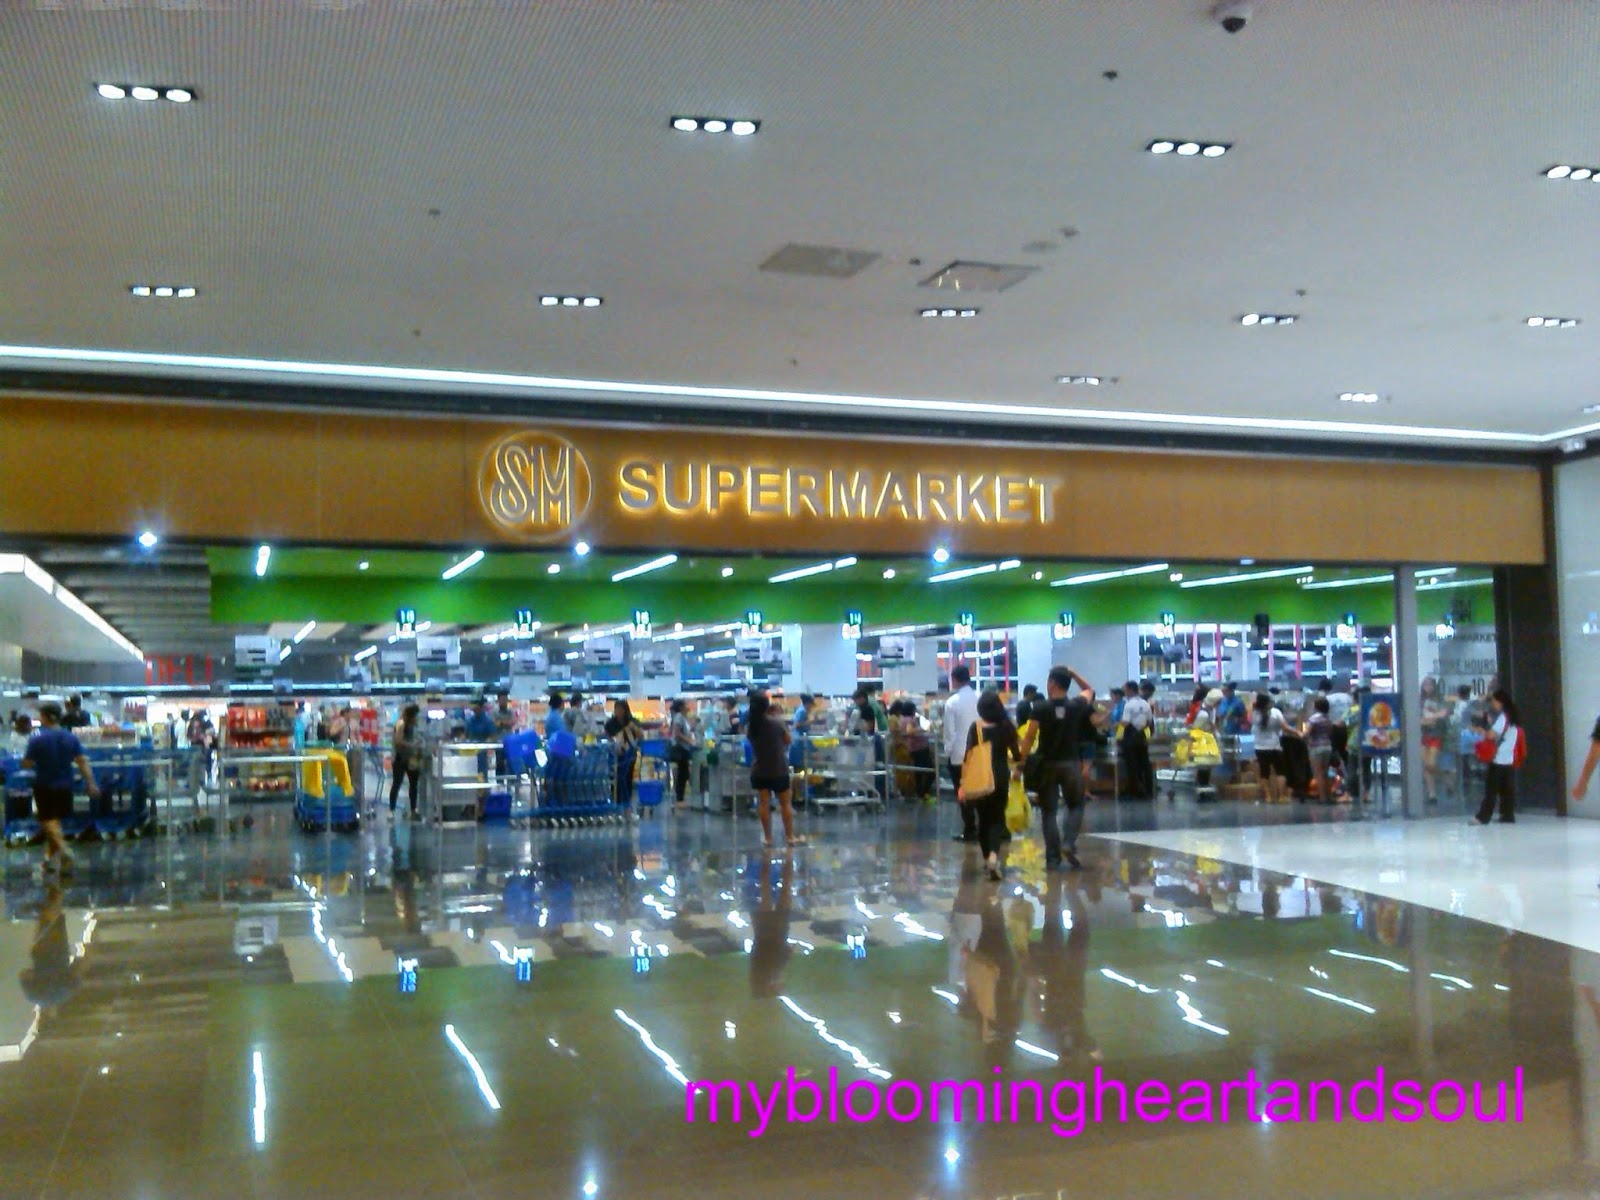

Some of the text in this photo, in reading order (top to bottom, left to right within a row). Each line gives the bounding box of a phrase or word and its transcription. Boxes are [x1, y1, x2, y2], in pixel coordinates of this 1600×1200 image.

[490, 443, 1060, 525] SM SUPERMARKET
[145, 655, 212, 687] DELI
